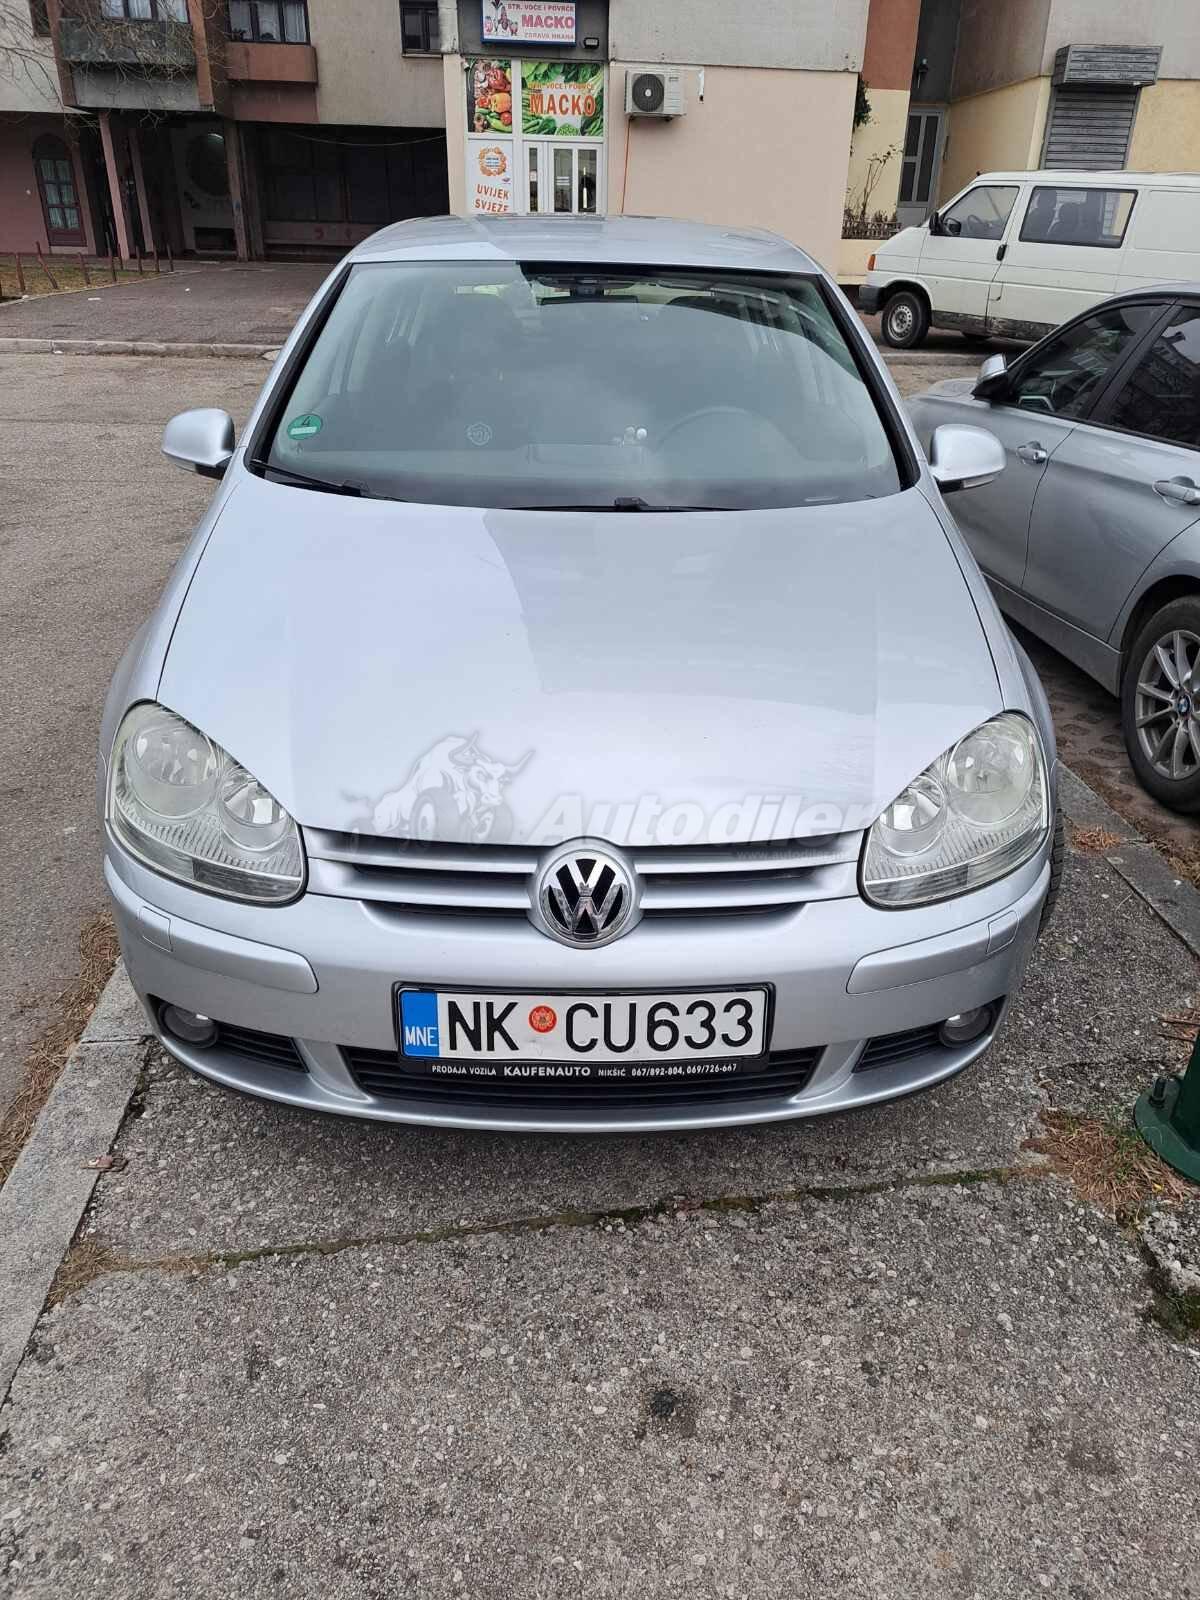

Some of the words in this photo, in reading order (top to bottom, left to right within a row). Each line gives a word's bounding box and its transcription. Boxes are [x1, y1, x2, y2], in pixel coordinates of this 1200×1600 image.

[521, 14, 575, 29] MACKO
[529, 93, 596, 116] MACKO
[477, 183, 510, 201] UVIJEK
[405, 1025, 438, 1047] MNE
[447, 1000, 519, 1052] NK
[565, 998, 754, 1054] CU633
[431, 1065, 468, 1075] PRODAJA
[469, 1066, 497, 1076] VOZILA
[503, 1066, 591, 1077] KAUFENAUTO
